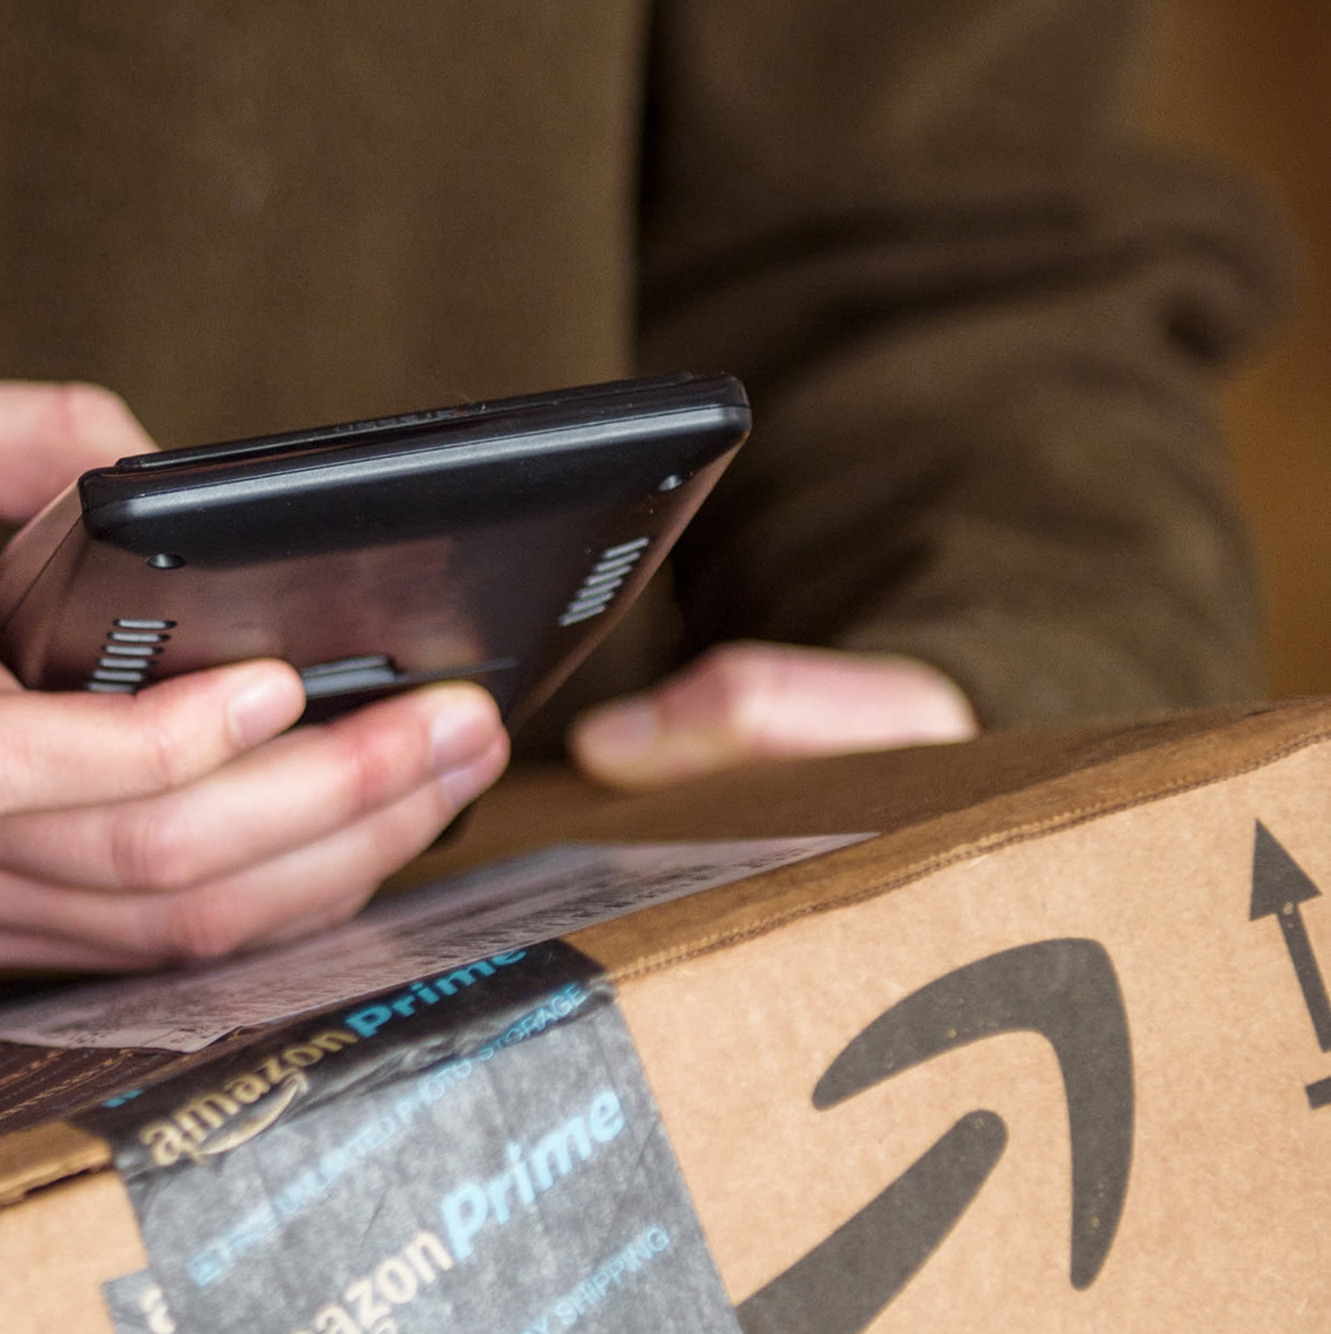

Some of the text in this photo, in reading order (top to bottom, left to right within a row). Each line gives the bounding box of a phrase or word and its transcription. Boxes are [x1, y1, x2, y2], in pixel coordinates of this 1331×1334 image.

[396, 1058, 472, 1121] PHOTO
[477, 982, 588, 1061] STORAGE
[555, 1224, 671, 1327] SHIPPING
